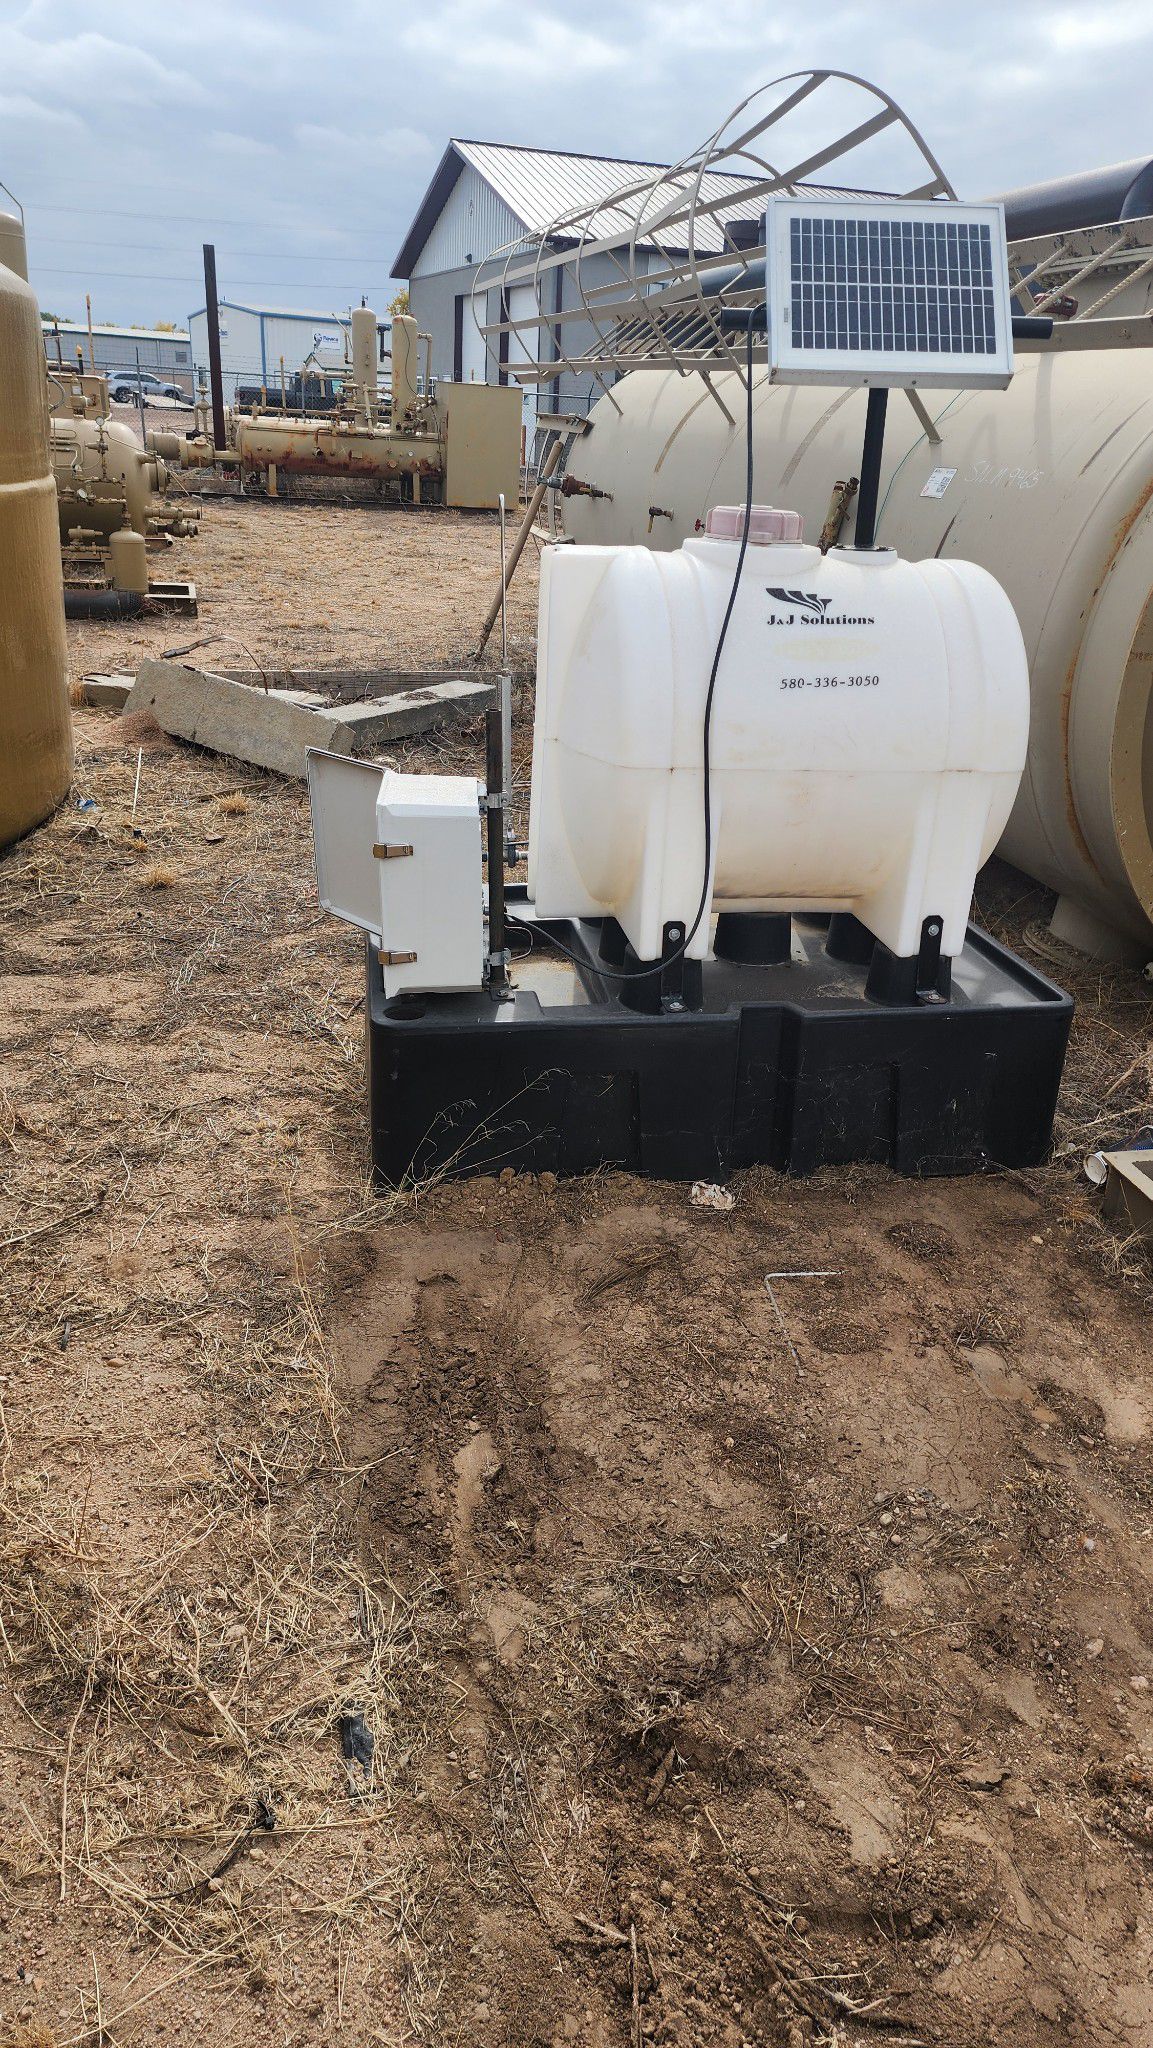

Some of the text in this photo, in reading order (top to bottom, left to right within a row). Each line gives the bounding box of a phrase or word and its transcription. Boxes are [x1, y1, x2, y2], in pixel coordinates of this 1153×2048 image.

[767, 614, 875, 626] J&J Solutions
[779, 675, 880, 690] 580-336-3050
